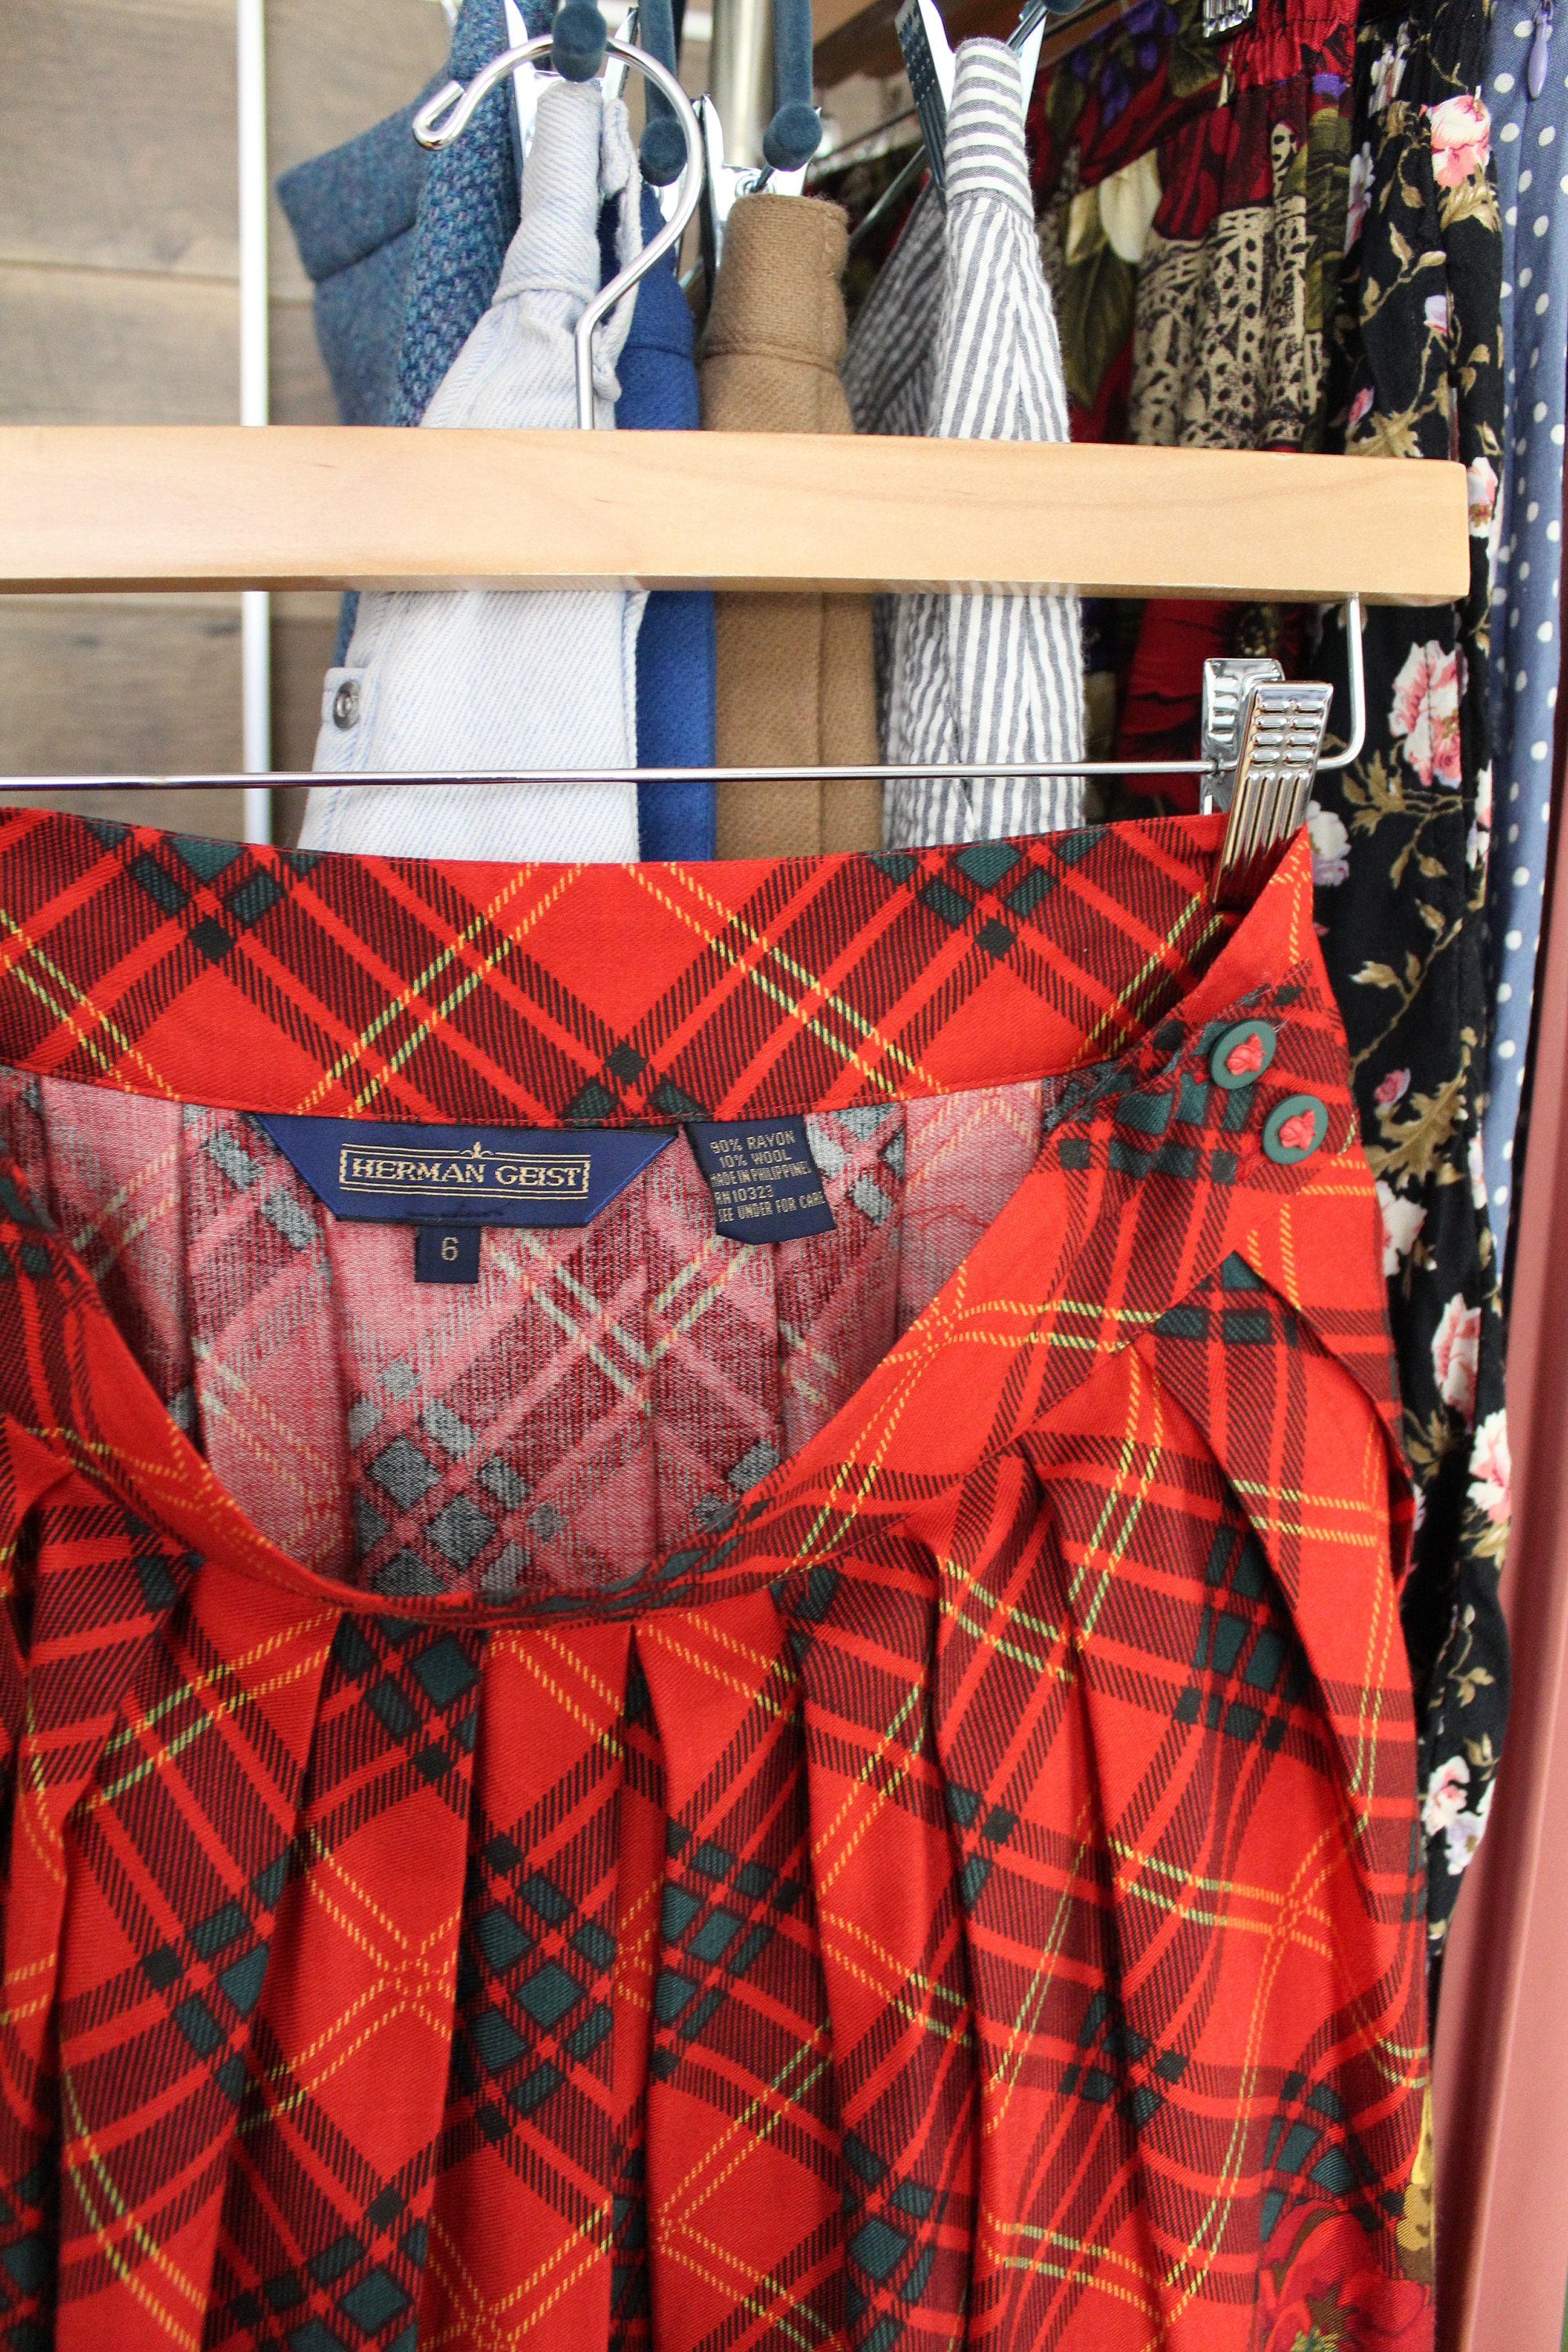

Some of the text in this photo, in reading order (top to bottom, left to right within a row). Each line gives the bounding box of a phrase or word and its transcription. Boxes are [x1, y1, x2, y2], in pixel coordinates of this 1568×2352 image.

[710, 1131, 795, 1153] 90% RAYON
[719, 1149, 792, 1168] 10% WOOL
[352, 1158, 581, 1186] HERMAN GEIST
[709, 1171, 738, 1187] MADE
[718, 1191, 826, 1223] SEE UNDER FOR CARE
[441, 1236, 459, 1261] 6
